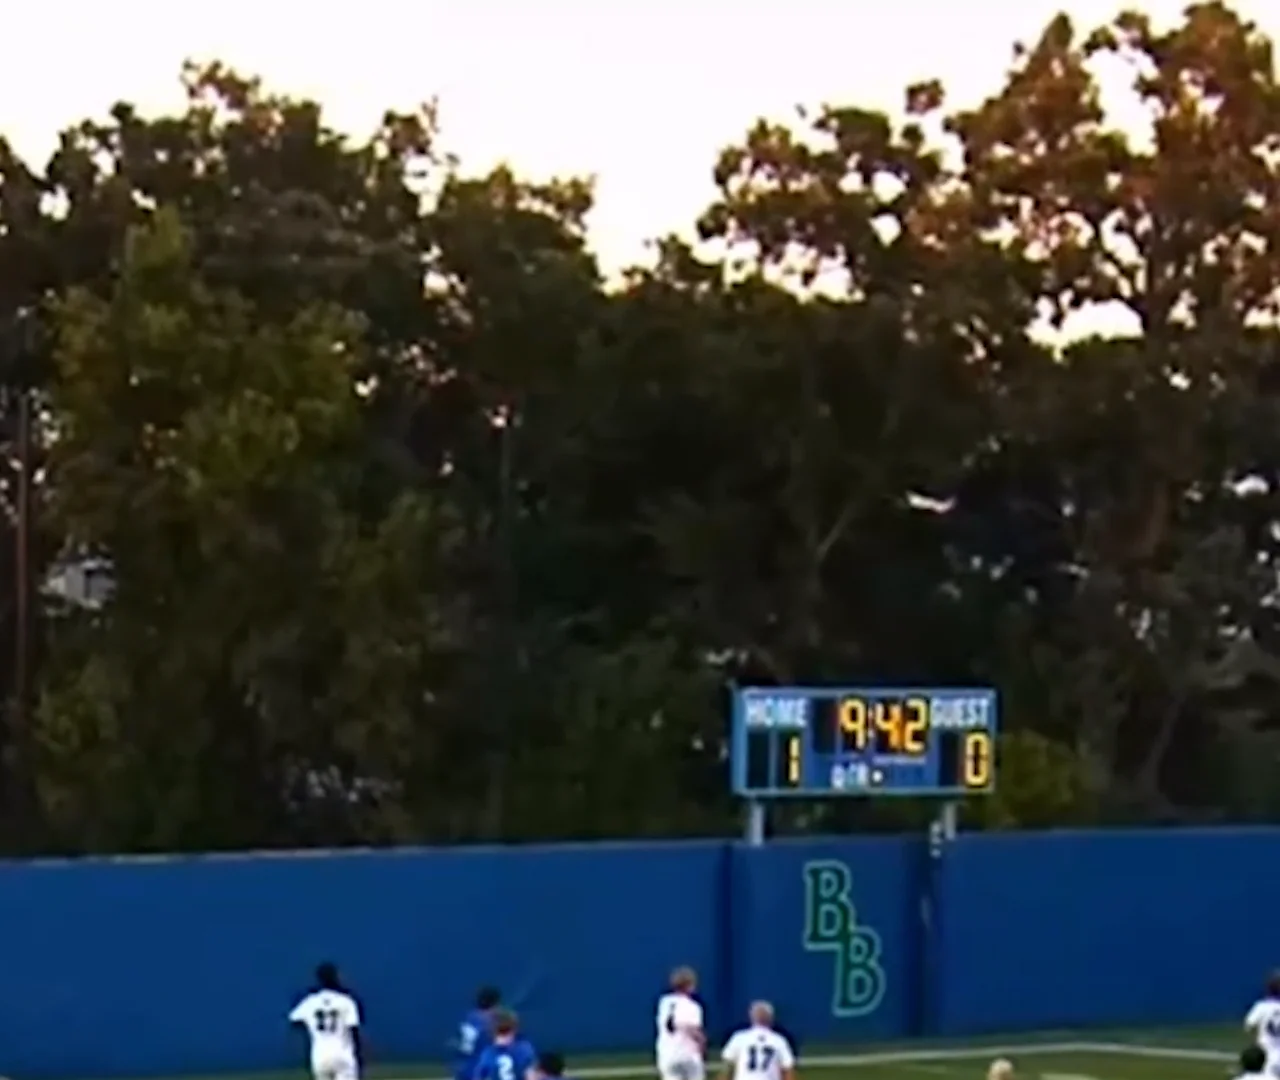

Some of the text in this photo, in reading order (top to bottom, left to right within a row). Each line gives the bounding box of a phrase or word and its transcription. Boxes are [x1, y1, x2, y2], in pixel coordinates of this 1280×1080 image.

[746, 697, 808, 727] HOME
[840, 697, 927, 751] 9:42
[930, 697, 989, 727] GUEST
[965, 732, 990, 786] 0
[748, 1044, 776, 1073] 17
